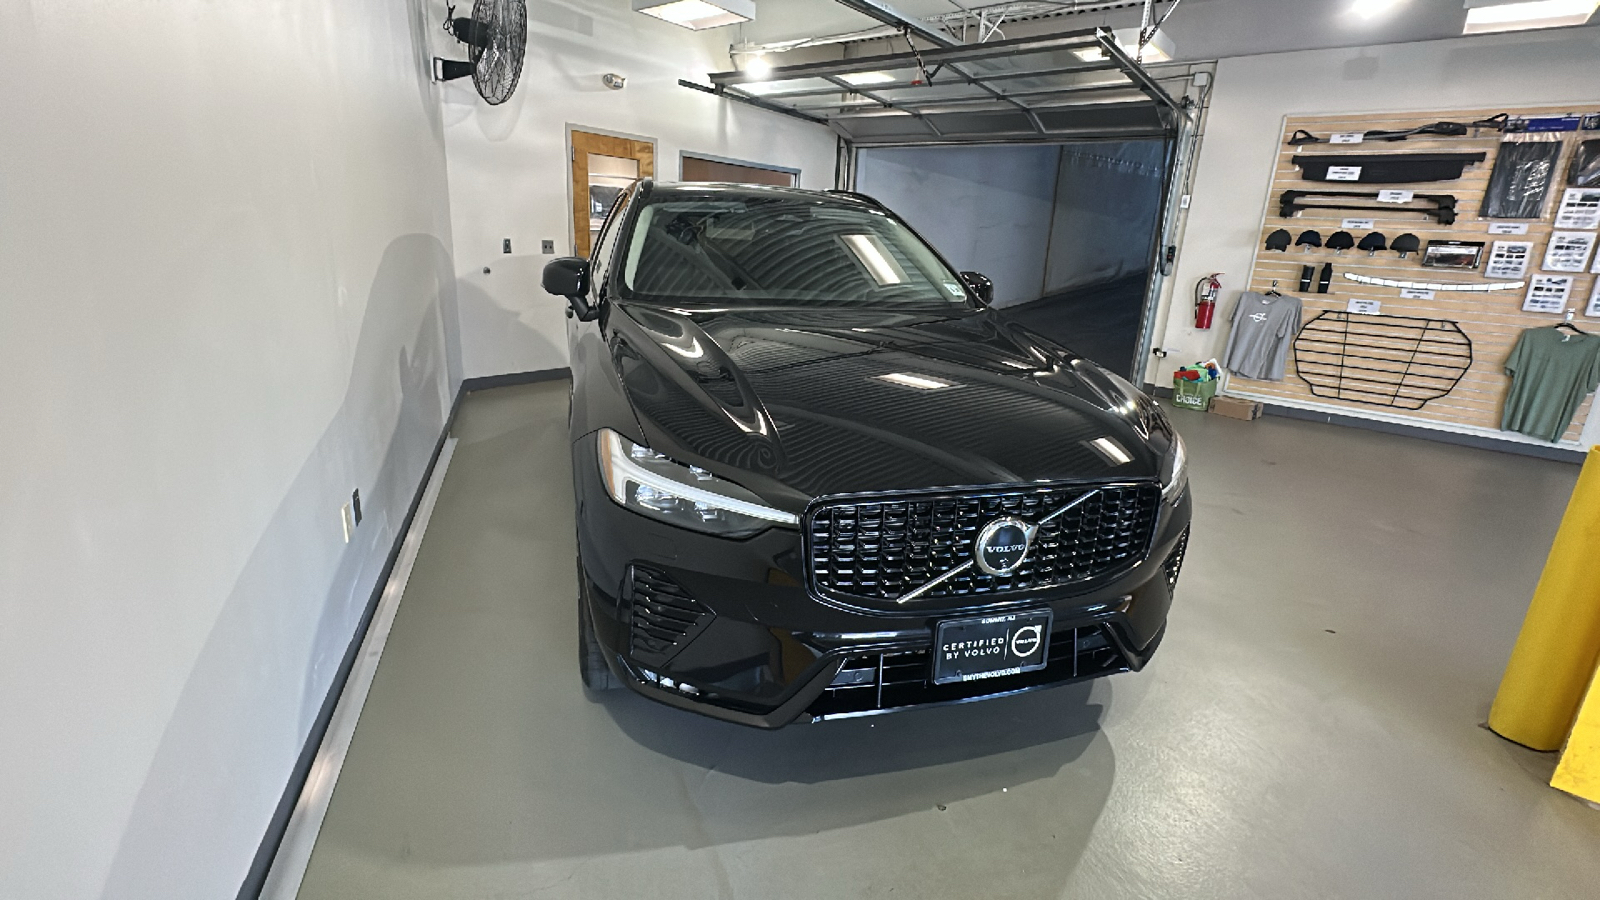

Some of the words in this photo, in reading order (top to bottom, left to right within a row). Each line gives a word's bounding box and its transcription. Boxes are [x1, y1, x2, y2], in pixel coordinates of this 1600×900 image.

[1176, 394, 1202, 406] CHOICE
[986, 544, 1025, 553] VOLVO
[943, 638, 1004, 651] CERTIFIED
[946, 651, 959, 660] BY
[965, 646, 1000, 658] VOLVO
